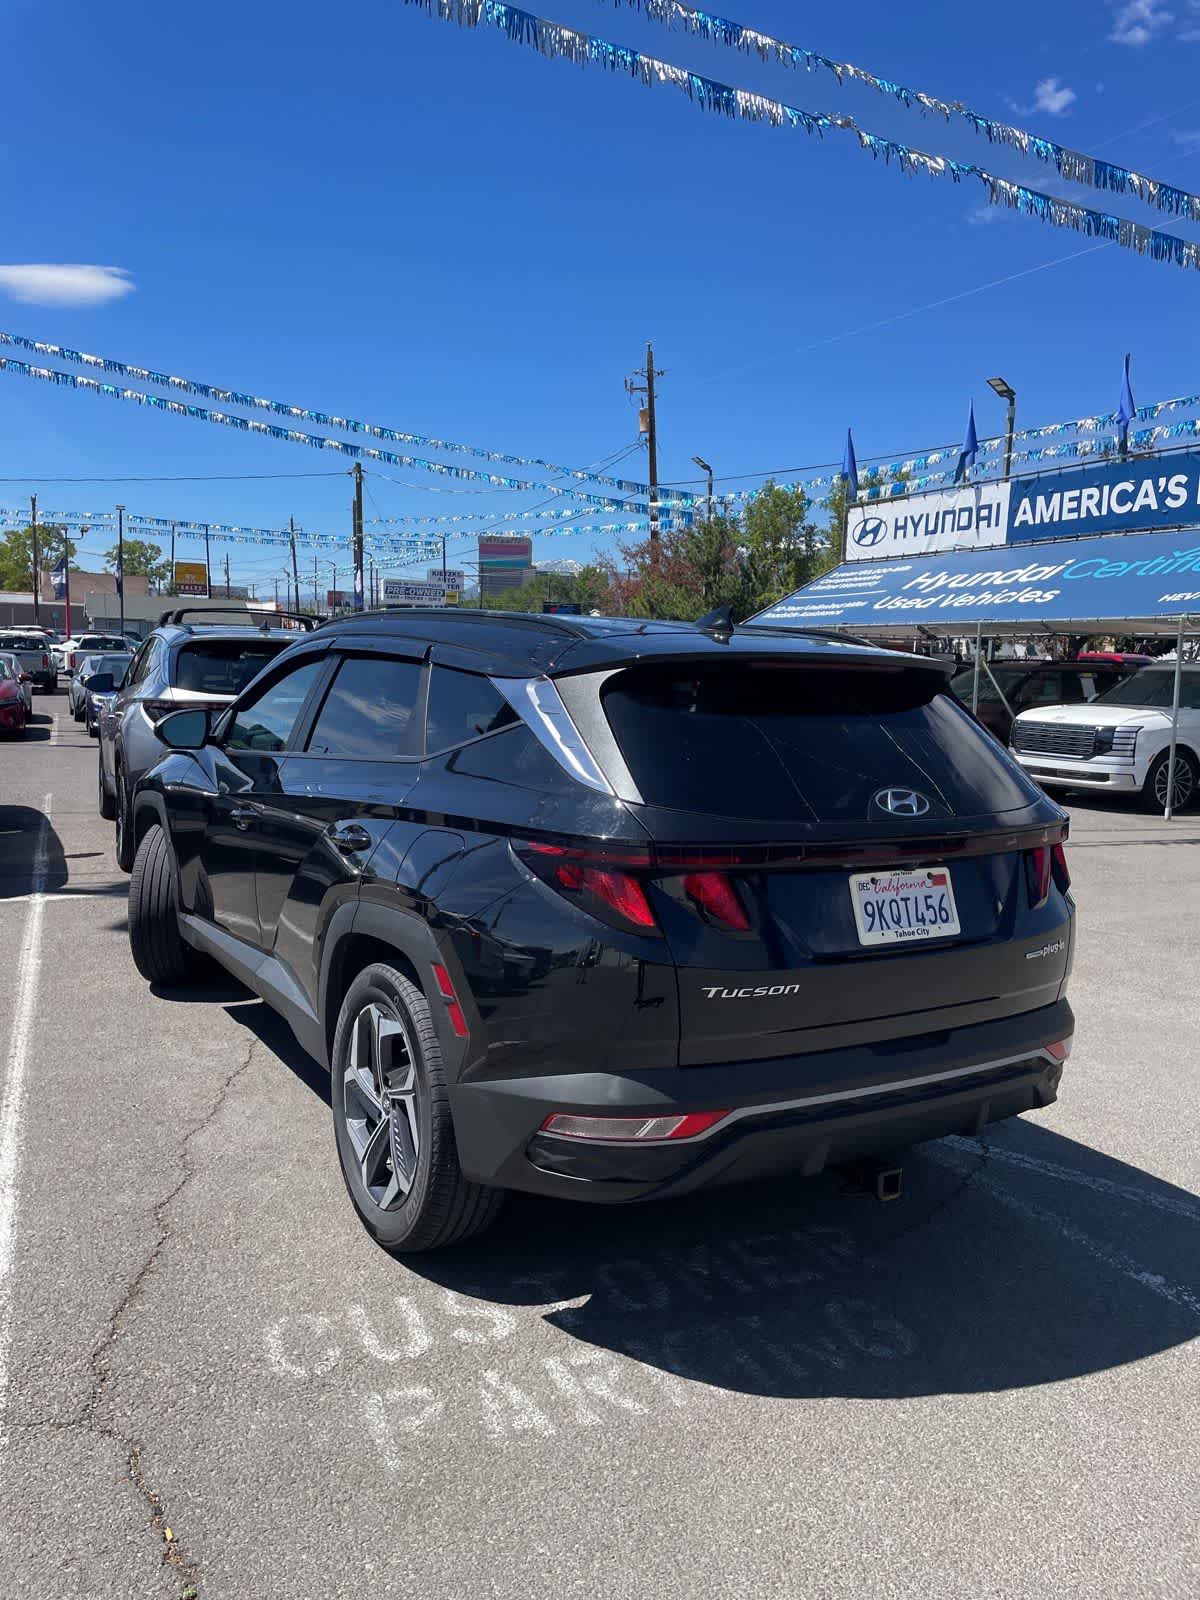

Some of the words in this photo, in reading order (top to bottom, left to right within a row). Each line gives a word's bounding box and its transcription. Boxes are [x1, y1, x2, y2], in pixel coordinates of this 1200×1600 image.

[893, 502, 1001, 540] HYUNDAI
[1014, 475, 1189, 528] AMERICA'S
[902, 559, 1071, 594] Hyundai
[386, 586, 445, 597] PRE-OWNED
[873, 594, 945, 610] Used
[940, 587, 1062, 608] Vehicles
[858, 882, 871, 891] DEC
[873, 877, 932, 897] California
[864, 893, 950, 932] 9KQT456
[895, 929, 916, 938] Tahoe
[917, 927, 930, 937] City
